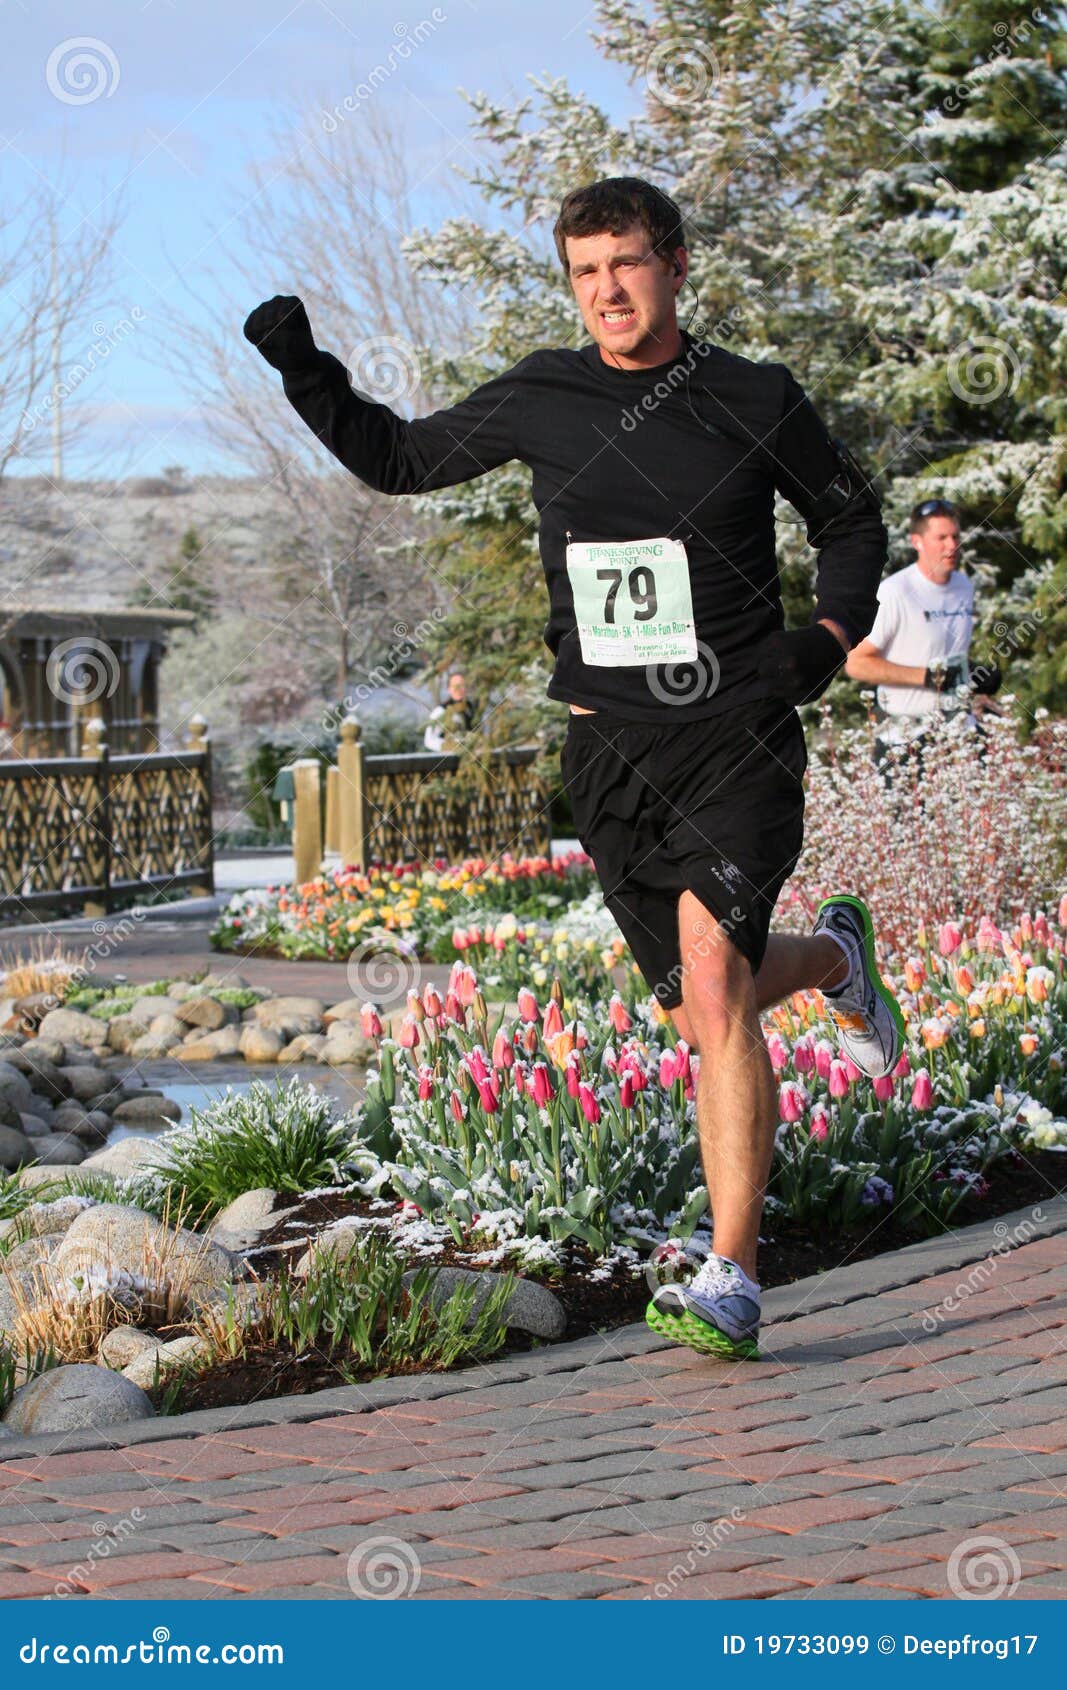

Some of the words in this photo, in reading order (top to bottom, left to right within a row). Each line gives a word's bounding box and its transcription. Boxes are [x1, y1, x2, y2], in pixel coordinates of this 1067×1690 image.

[609, 556, 640, 566] POINT
[596, 566, 658, 625] 79
[659, 623, 671, 635] Fun
[672, 621, 686, 633] Run
